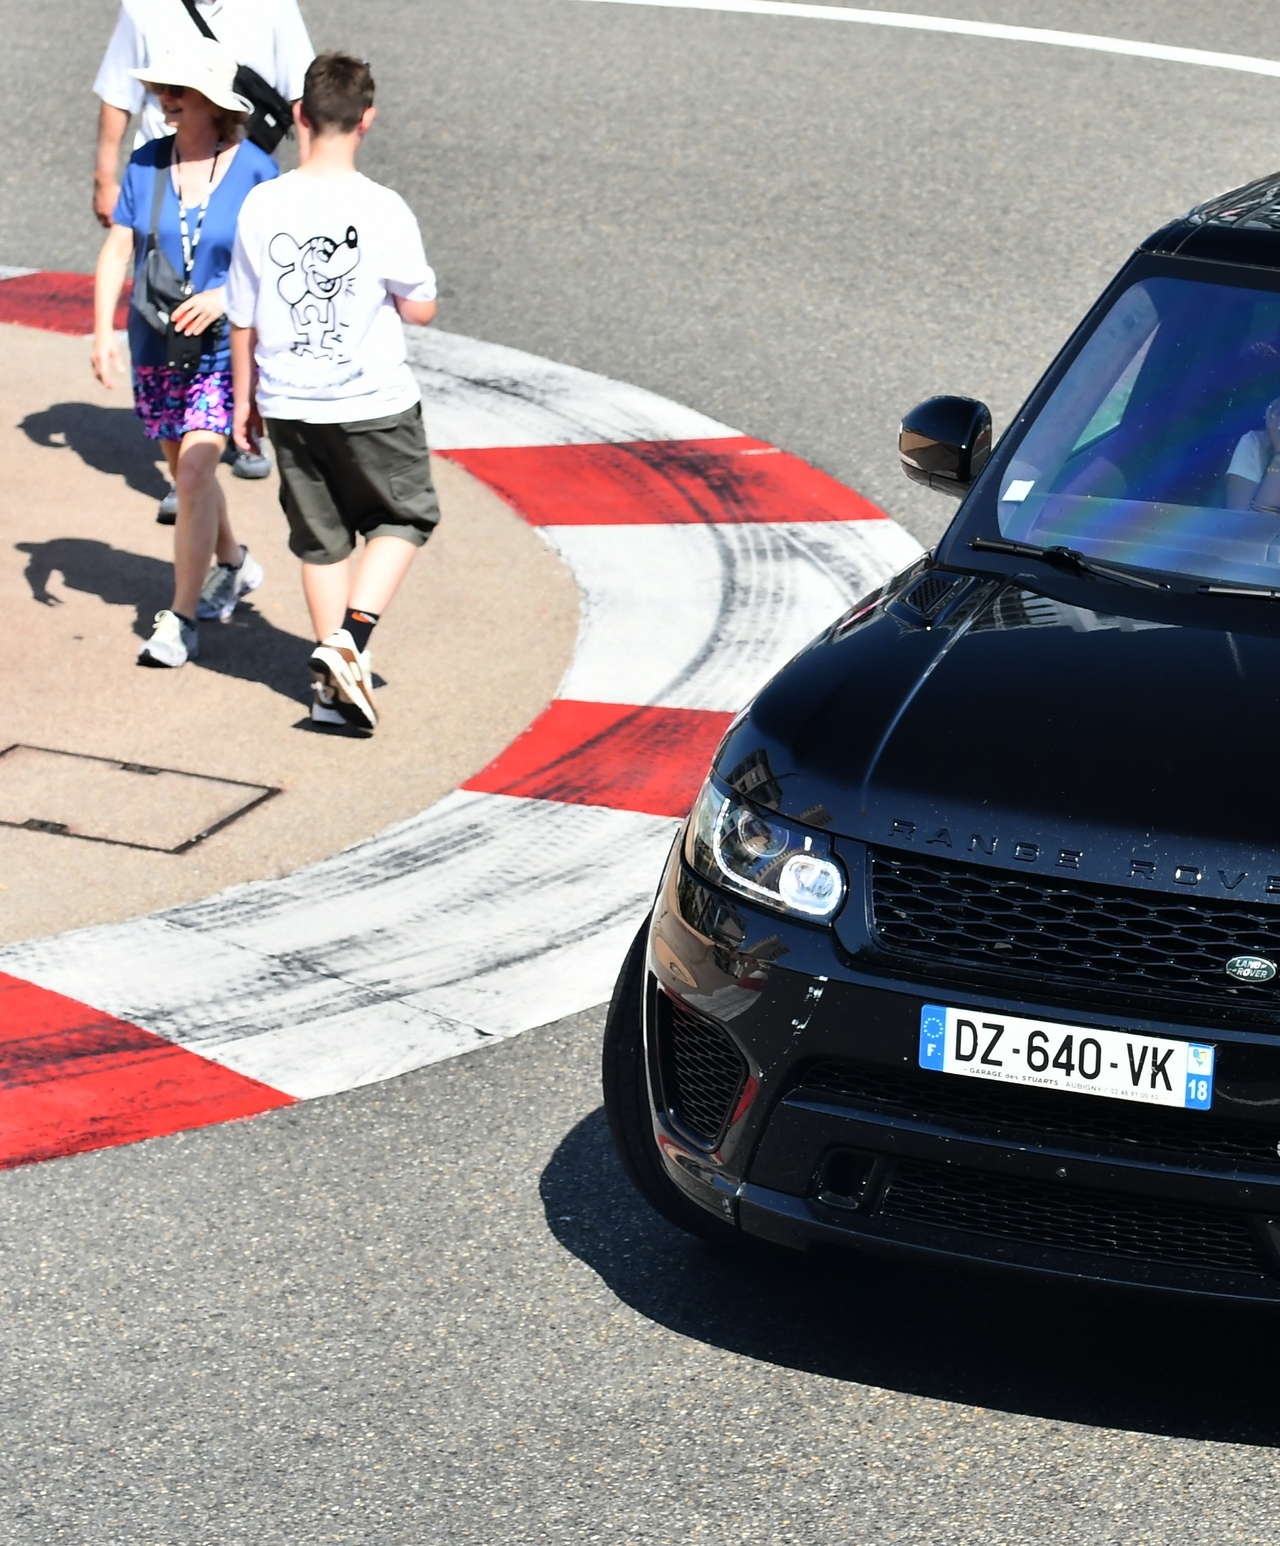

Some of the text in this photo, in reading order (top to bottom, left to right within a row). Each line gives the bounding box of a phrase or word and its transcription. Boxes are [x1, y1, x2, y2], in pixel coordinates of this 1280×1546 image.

[888, 818, 1085, 869] RANGE
[1235, 959, 1262, 969] LAND
[1236, 967, 1268, 979] ROVER
[926, 1043, 937, 1057] F
[955, 1018, 1175, 1092] DZ-640-VK
[969, 1067, 1002, 1078] GARAGE
[1022, 1075, 1059, 1086] STUARTS
[1187, 1078, 1209, 1102] 18
